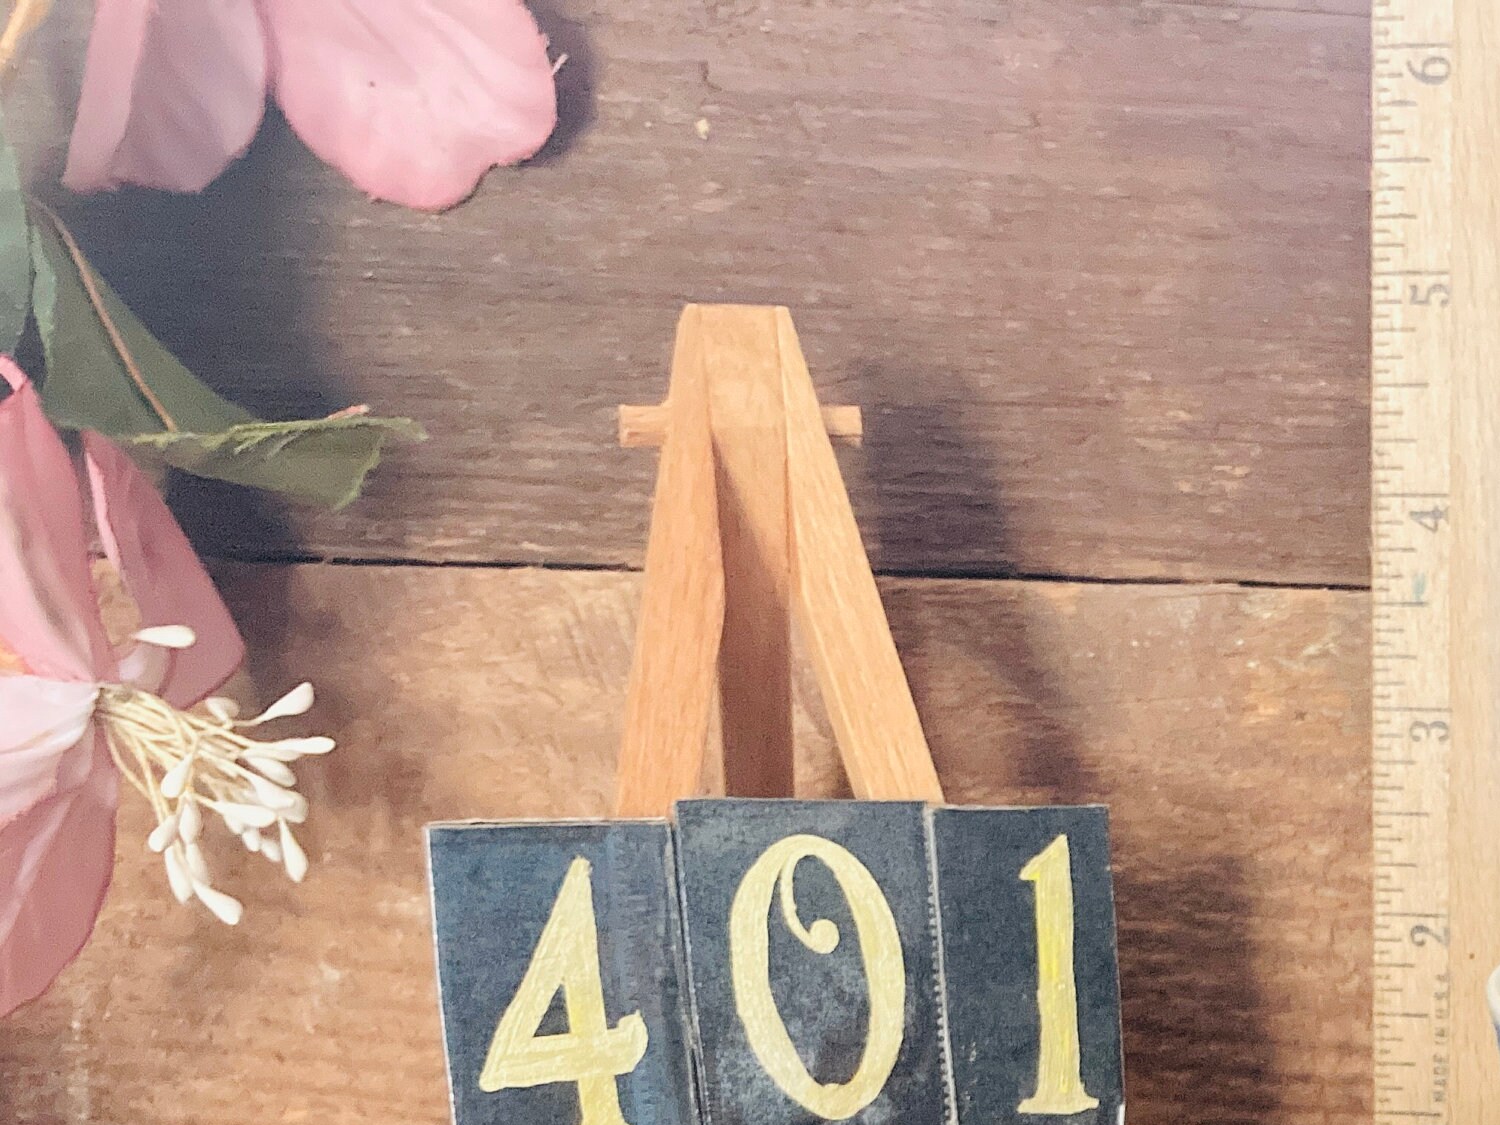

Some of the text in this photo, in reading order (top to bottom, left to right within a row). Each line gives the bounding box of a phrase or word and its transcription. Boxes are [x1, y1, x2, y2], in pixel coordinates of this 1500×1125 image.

[1406, 56, 1451, 85] 6
[1409, 283, 1449, 308] 5
[1409, 505, 1449, 532] 4
[1409, 720, 1449, 744] 3
[1409, 924, 1449, 948] 2
[1433, 1053, 1449, 1102] MADE
